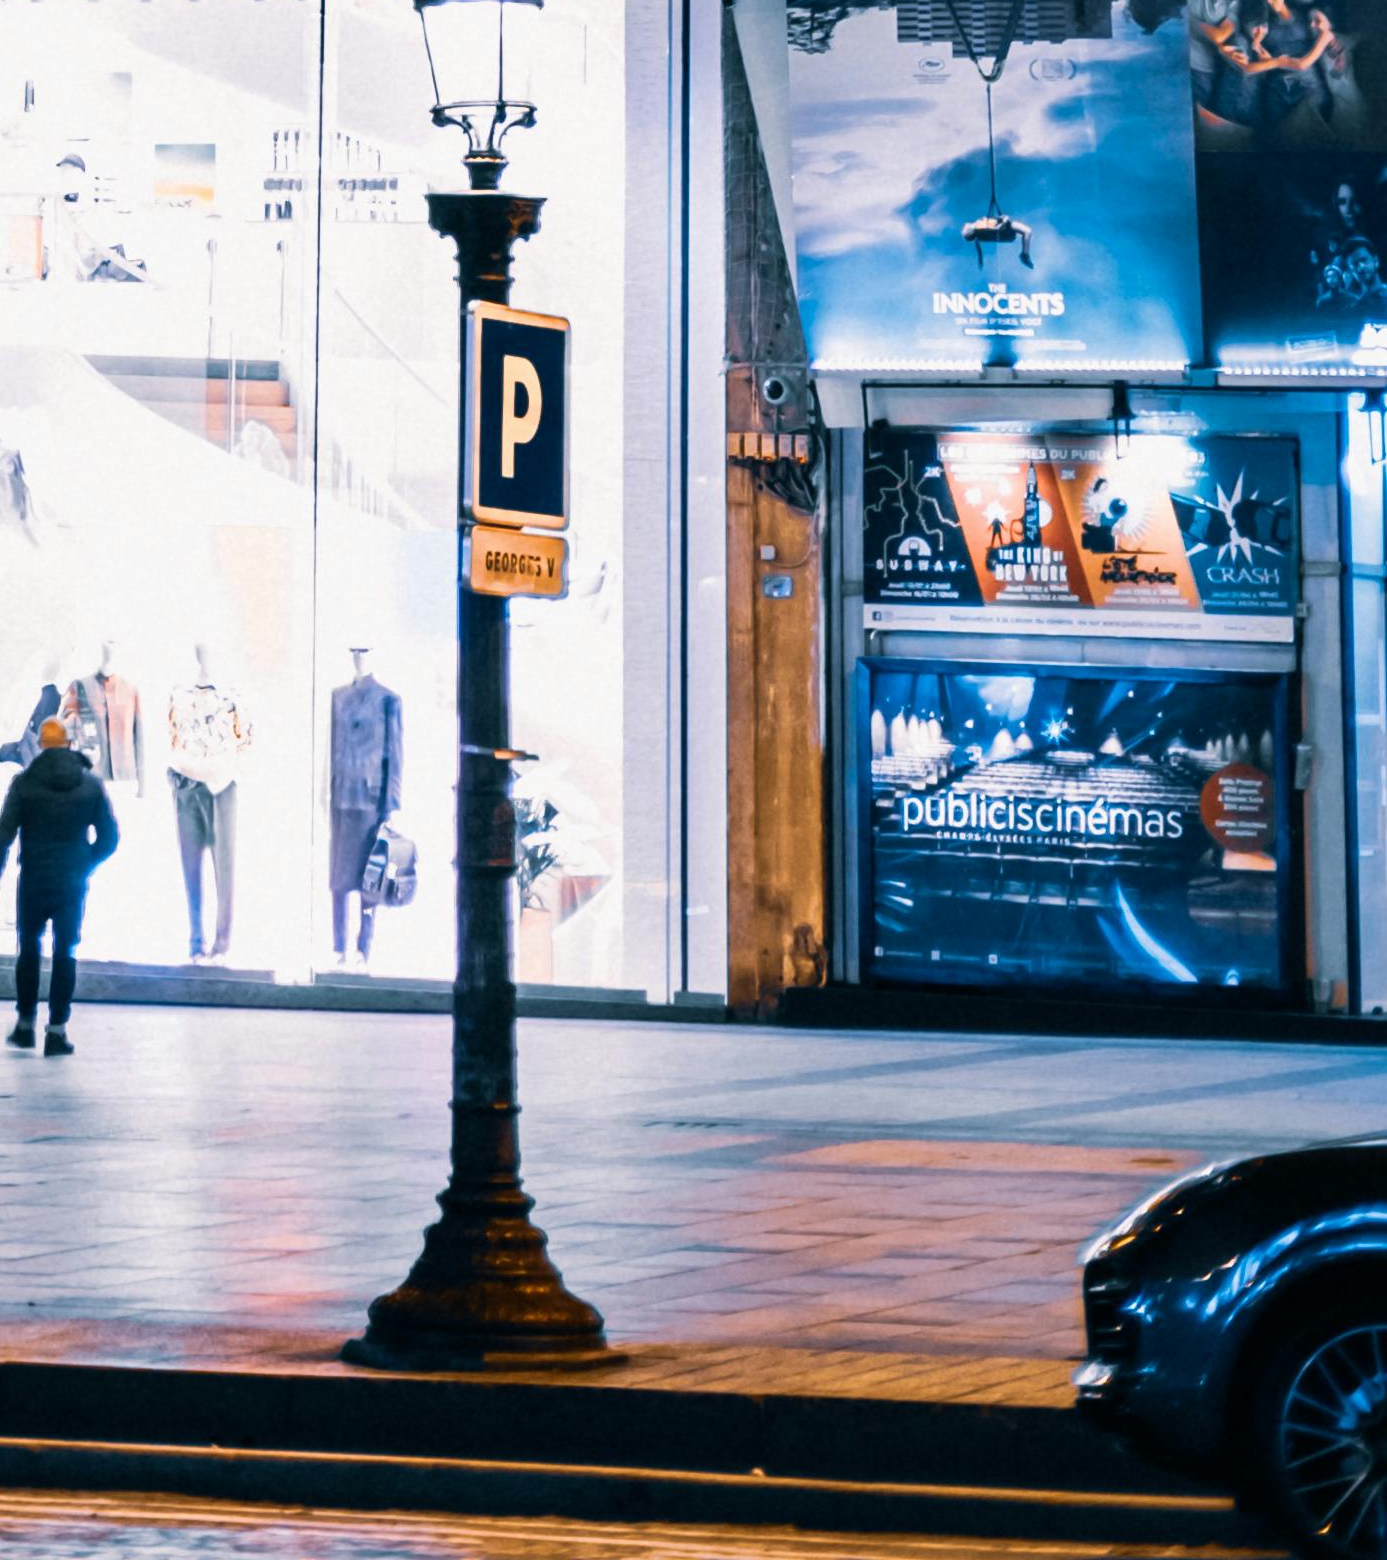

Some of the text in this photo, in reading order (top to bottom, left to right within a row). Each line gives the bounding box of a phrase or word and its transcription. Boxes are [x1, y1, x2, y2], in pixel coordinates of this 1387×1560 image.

[988, 283, 1007, 293] THE
[932, 292, 1065, 316] INNOCENTS
[501, 354, 542, 479] P
[547, 557, 556, 578] V
[876, 559, 958, 572] SUBWAY
[995, 564, 1068, 581] NEW YORK
[1206, 566, 1280, 585] CRASH
[902, 791, 1184, 839] publiciscinémas
